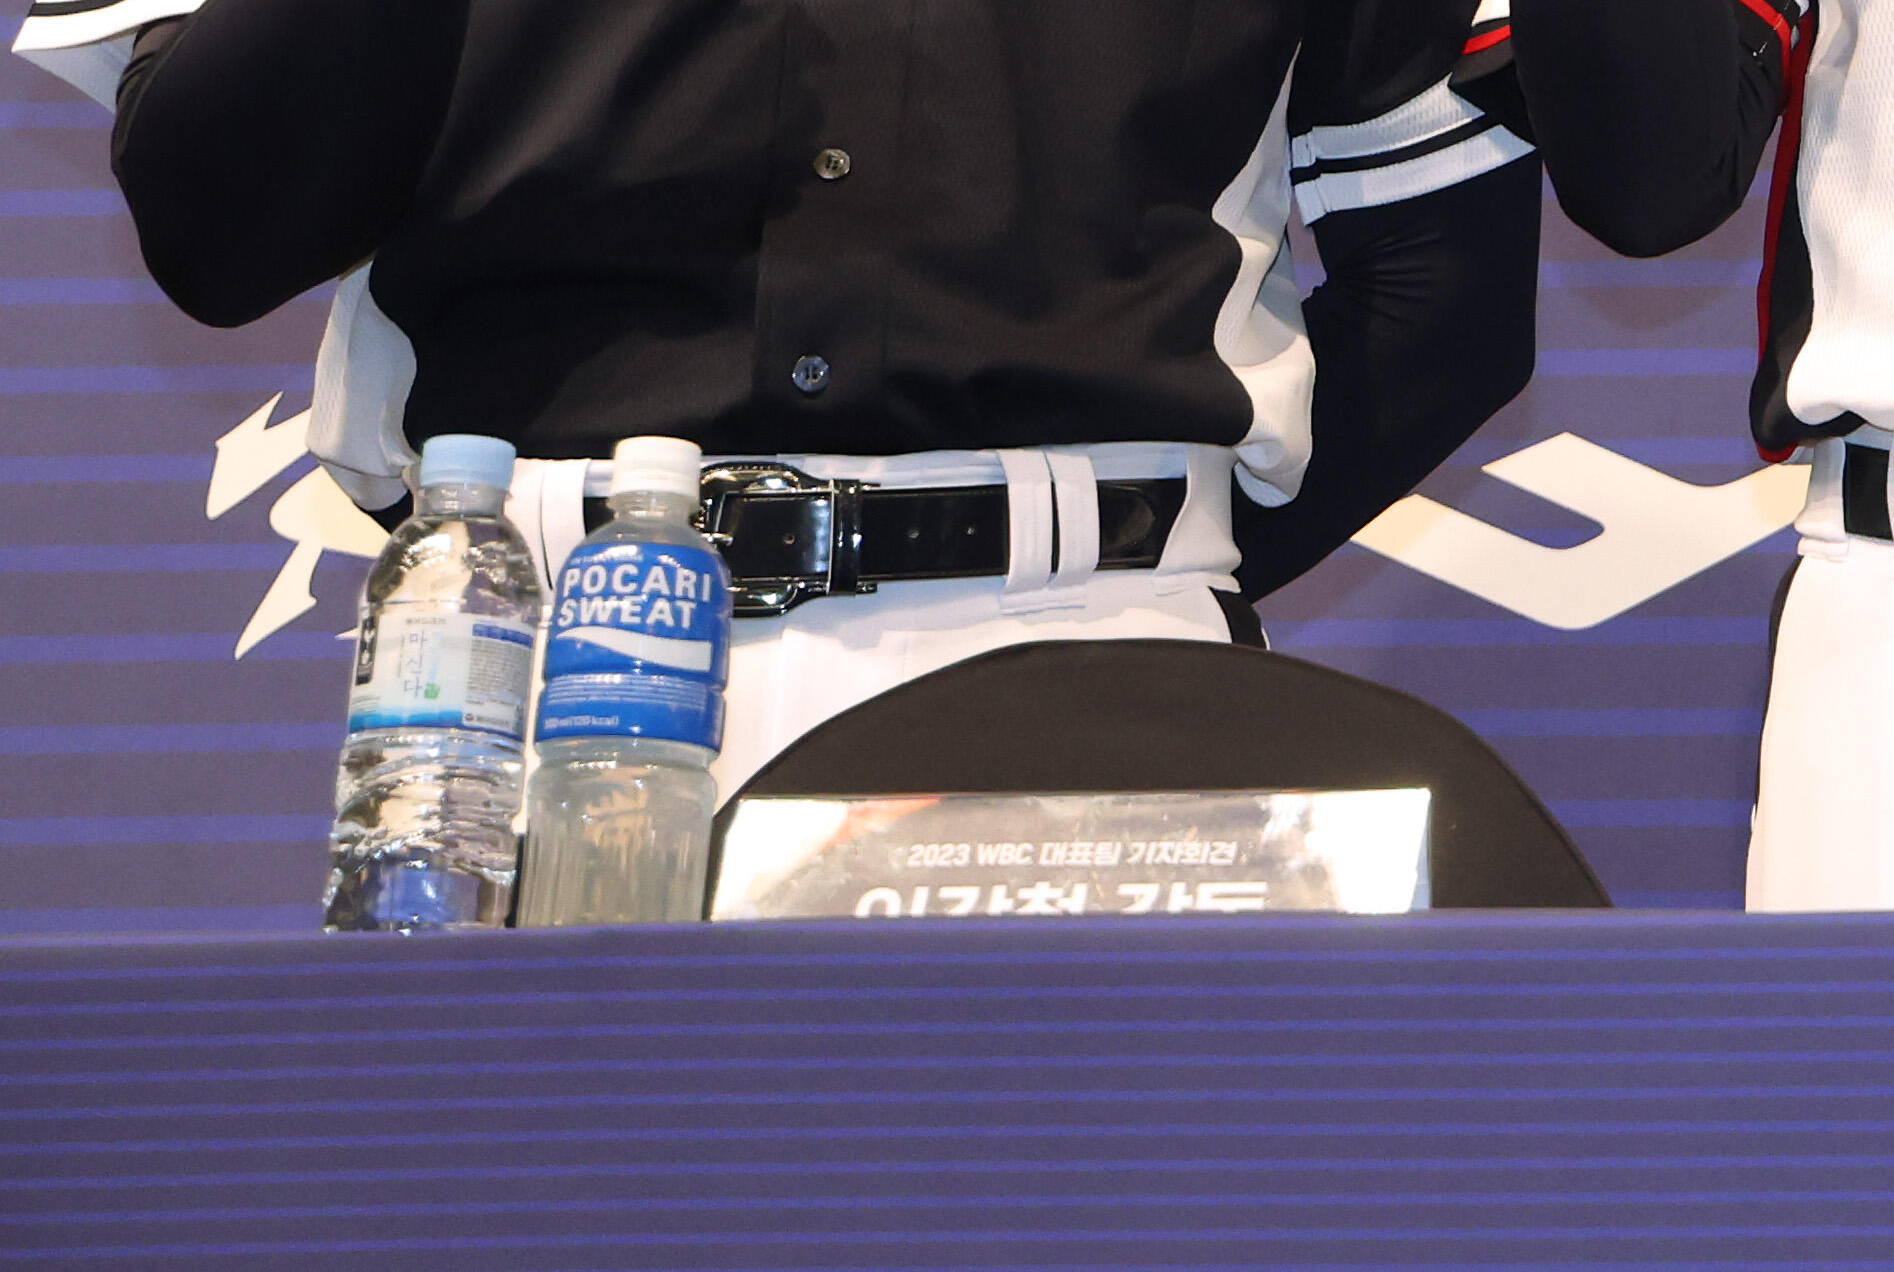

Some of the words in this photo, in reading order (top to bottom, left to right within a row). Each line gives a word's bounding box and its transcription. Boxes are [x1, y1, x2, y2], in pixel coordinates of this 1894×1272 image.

[563, 564, 711, 602] POCARI
[557, 595, 697, 629] SWEAT
[907, 842, 971, 866] 2023
[976, 842, 1034, 866] WBC
[1039, 841, 1121, 867] 대표팀
[1127, 841, 1238, 866] 기자회견
